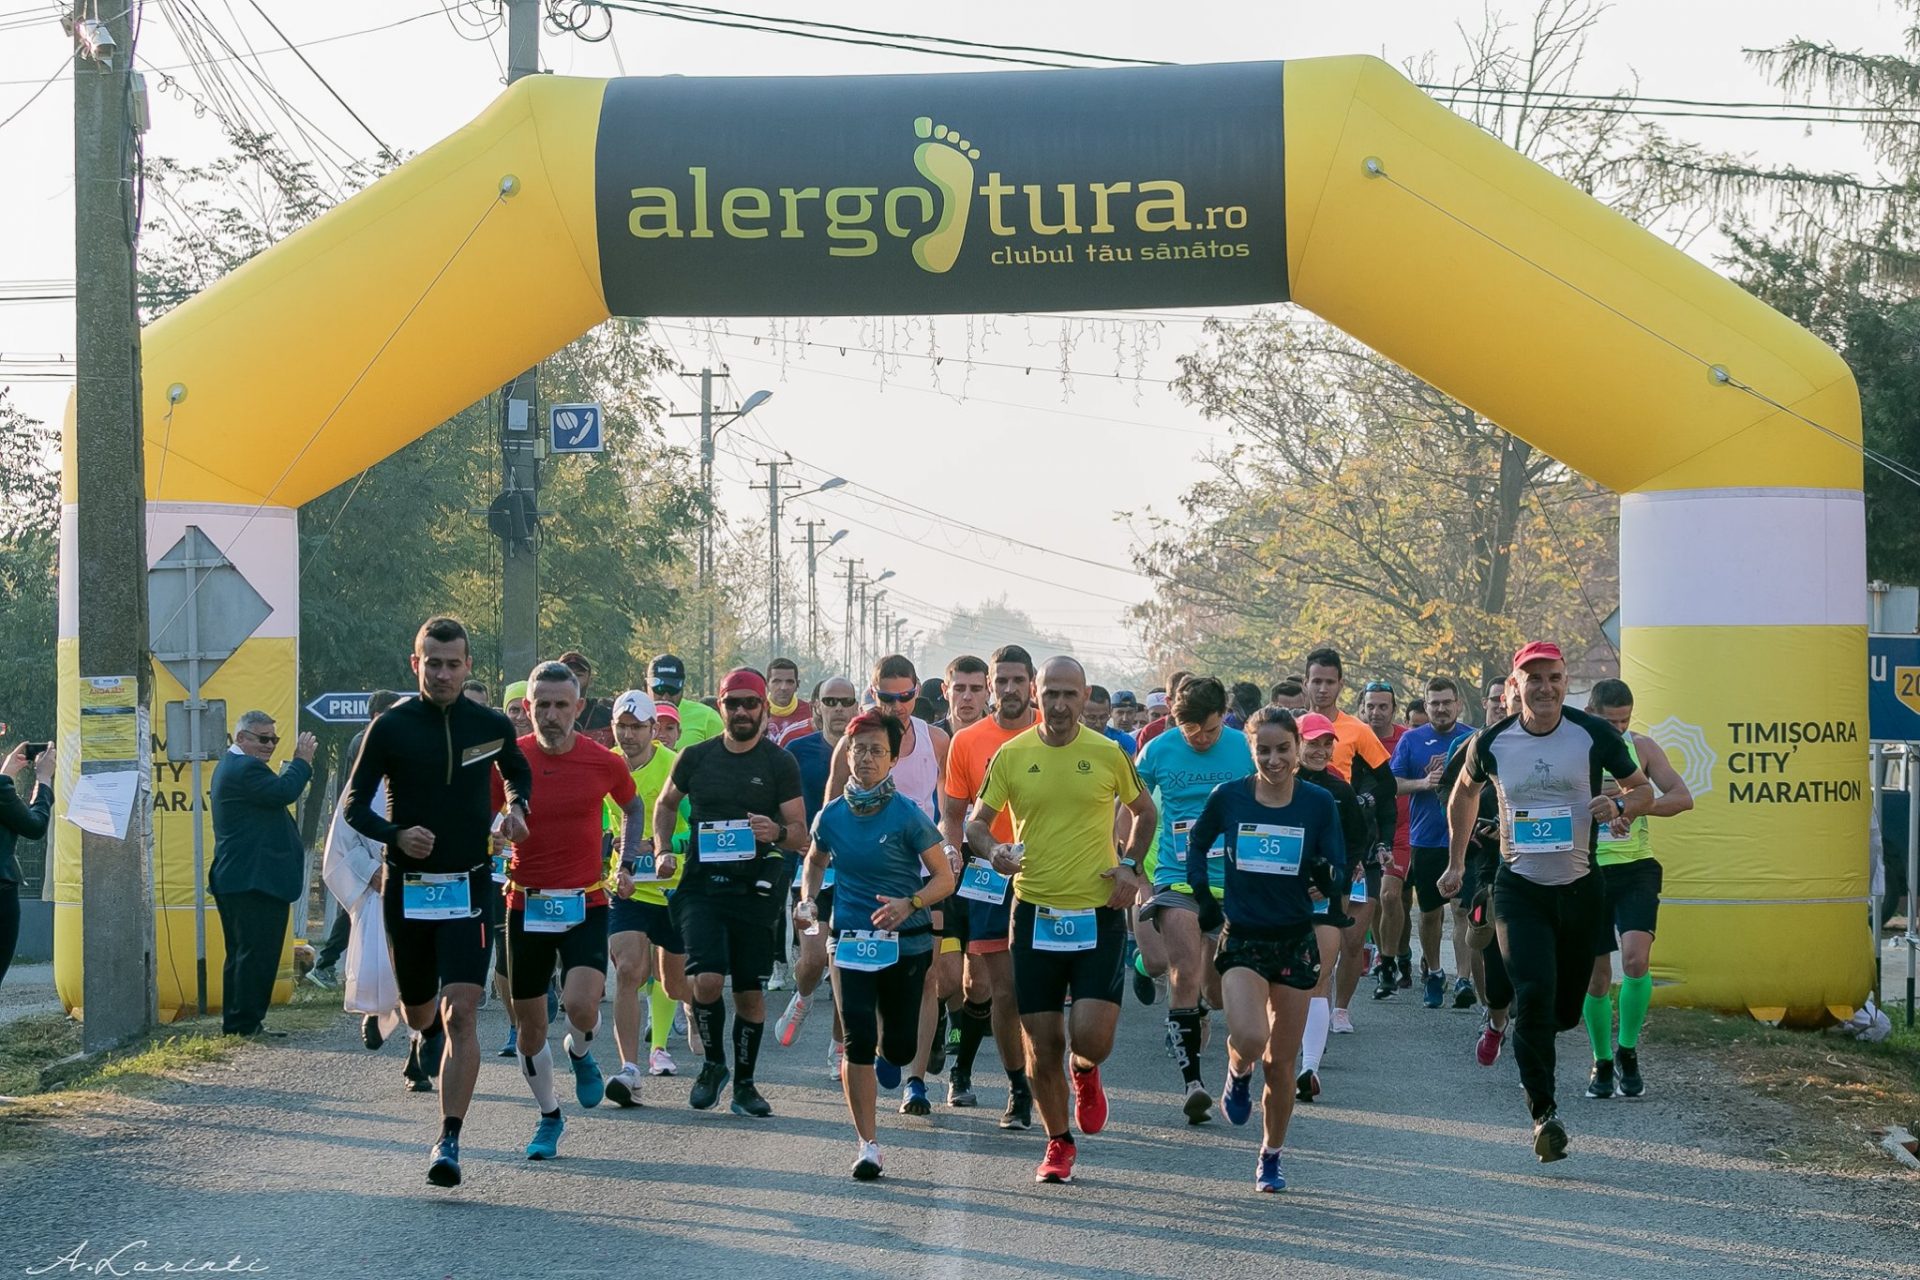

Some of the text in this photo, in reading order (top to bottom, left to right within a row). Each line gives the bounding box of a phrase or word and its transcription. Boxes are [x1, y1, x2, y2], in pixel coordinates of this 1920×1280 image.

[991, 245, 1074, 265] clubul
[1727, 752, 1791, 774] CITY
[1729, 780, 1861, 804] MARATHON
[1532, 821, 1552, 838] 32
[717, 832, 736, 847] 82
[1259, 838, 1280, 855] 35
[635, 855, 654, 868] 70
[974, 869, 990, 885] 29
[425, 886, 447, 901] 37
[544, 900, 565, 915] 95
[1054, 920, 1075, 936] 60
[856, 941, 877, 958] 96
